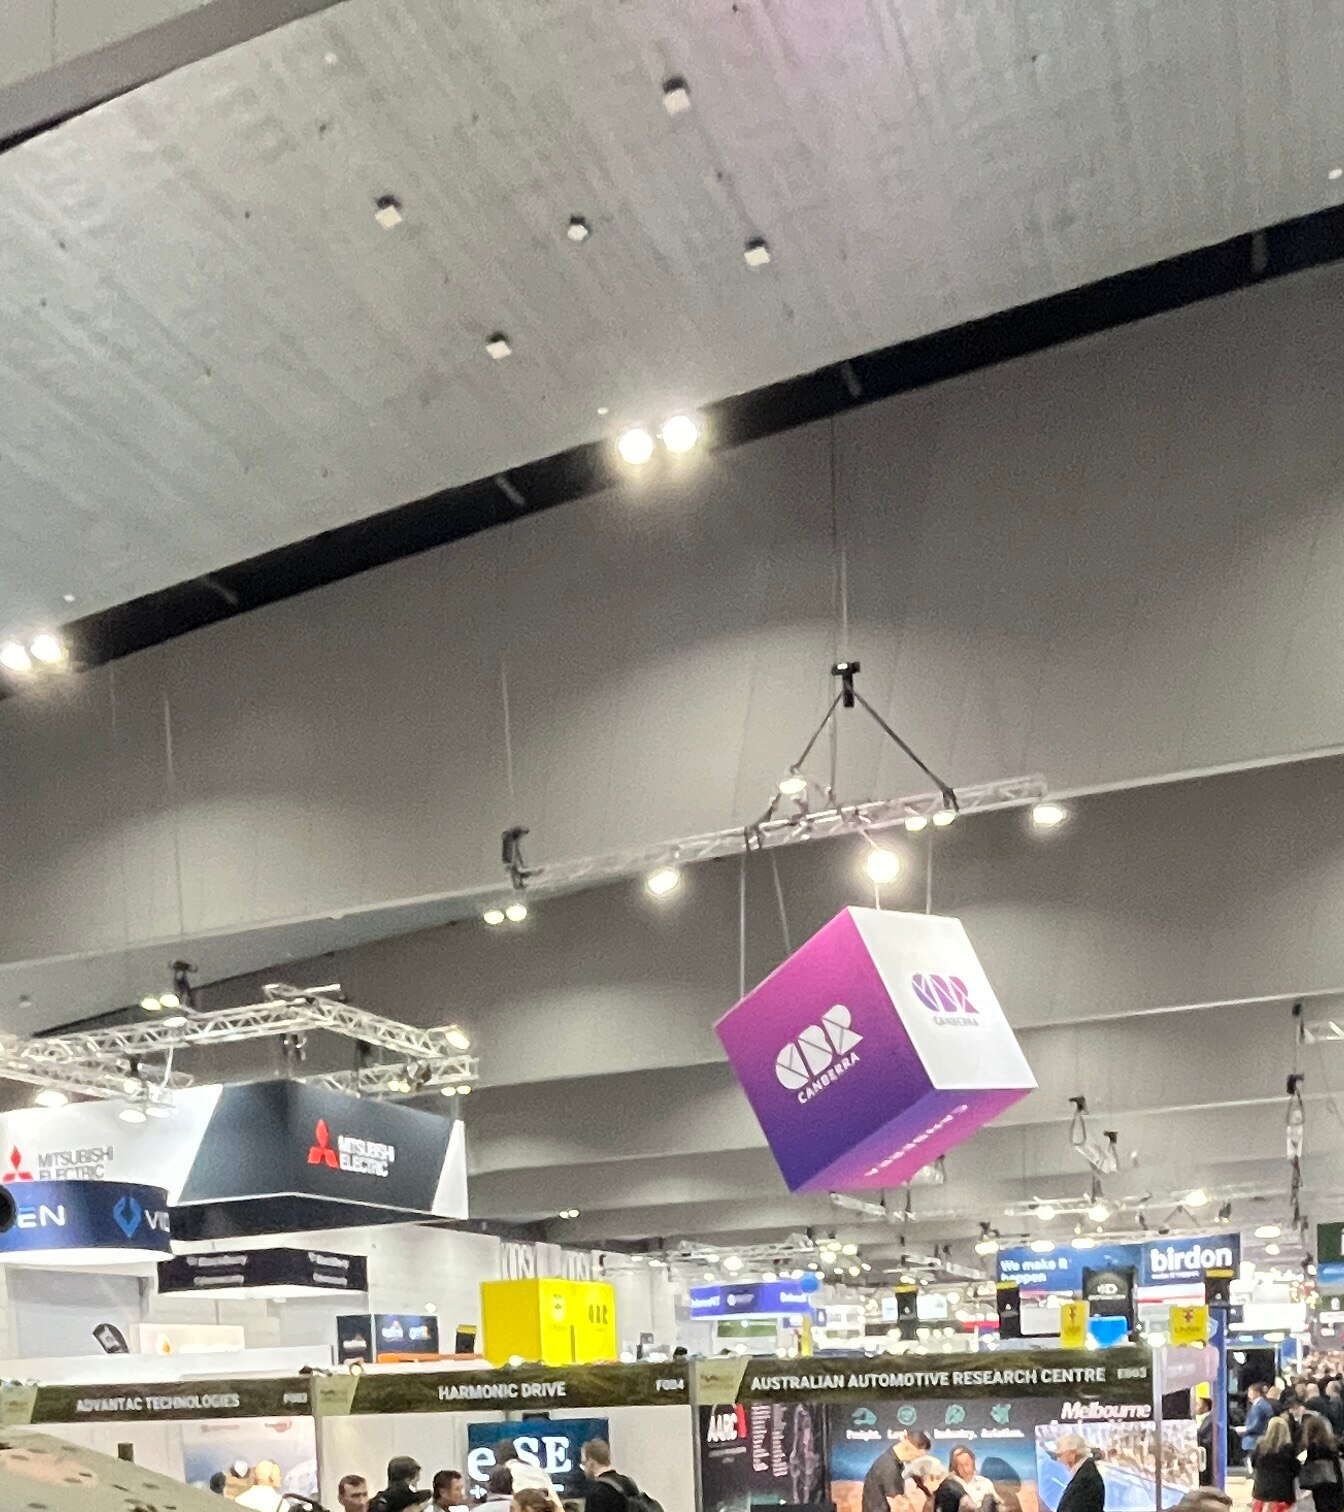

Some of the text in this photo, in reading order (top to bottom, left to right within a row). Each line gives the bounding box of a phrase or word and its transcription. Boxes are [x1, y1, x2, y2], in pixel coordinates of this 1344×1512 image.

[797, 1052, 860, 1104] CANBERRA
[38, 1146, 114, 1168] MITSUBISHI
[338, 1135, 395, 1162] MITSUBISHI
[39, 1164, 105, 1180] ELECTRIC
[340, 1151, 389, 1177] ELECTRIC
[1150, 1245, 1233, 1272] birdon
[438, 1381, 567, 1400] HARMONIC DRIVE
[751, 1367, 1106, 1391] AUSTRALIAN AUTOMOTIVE RESEARCH CENTRE
[146, 1393, 240, 1411] TECHNOLOGIES
[1061, 1401, 1151, 1420] Melbourne
